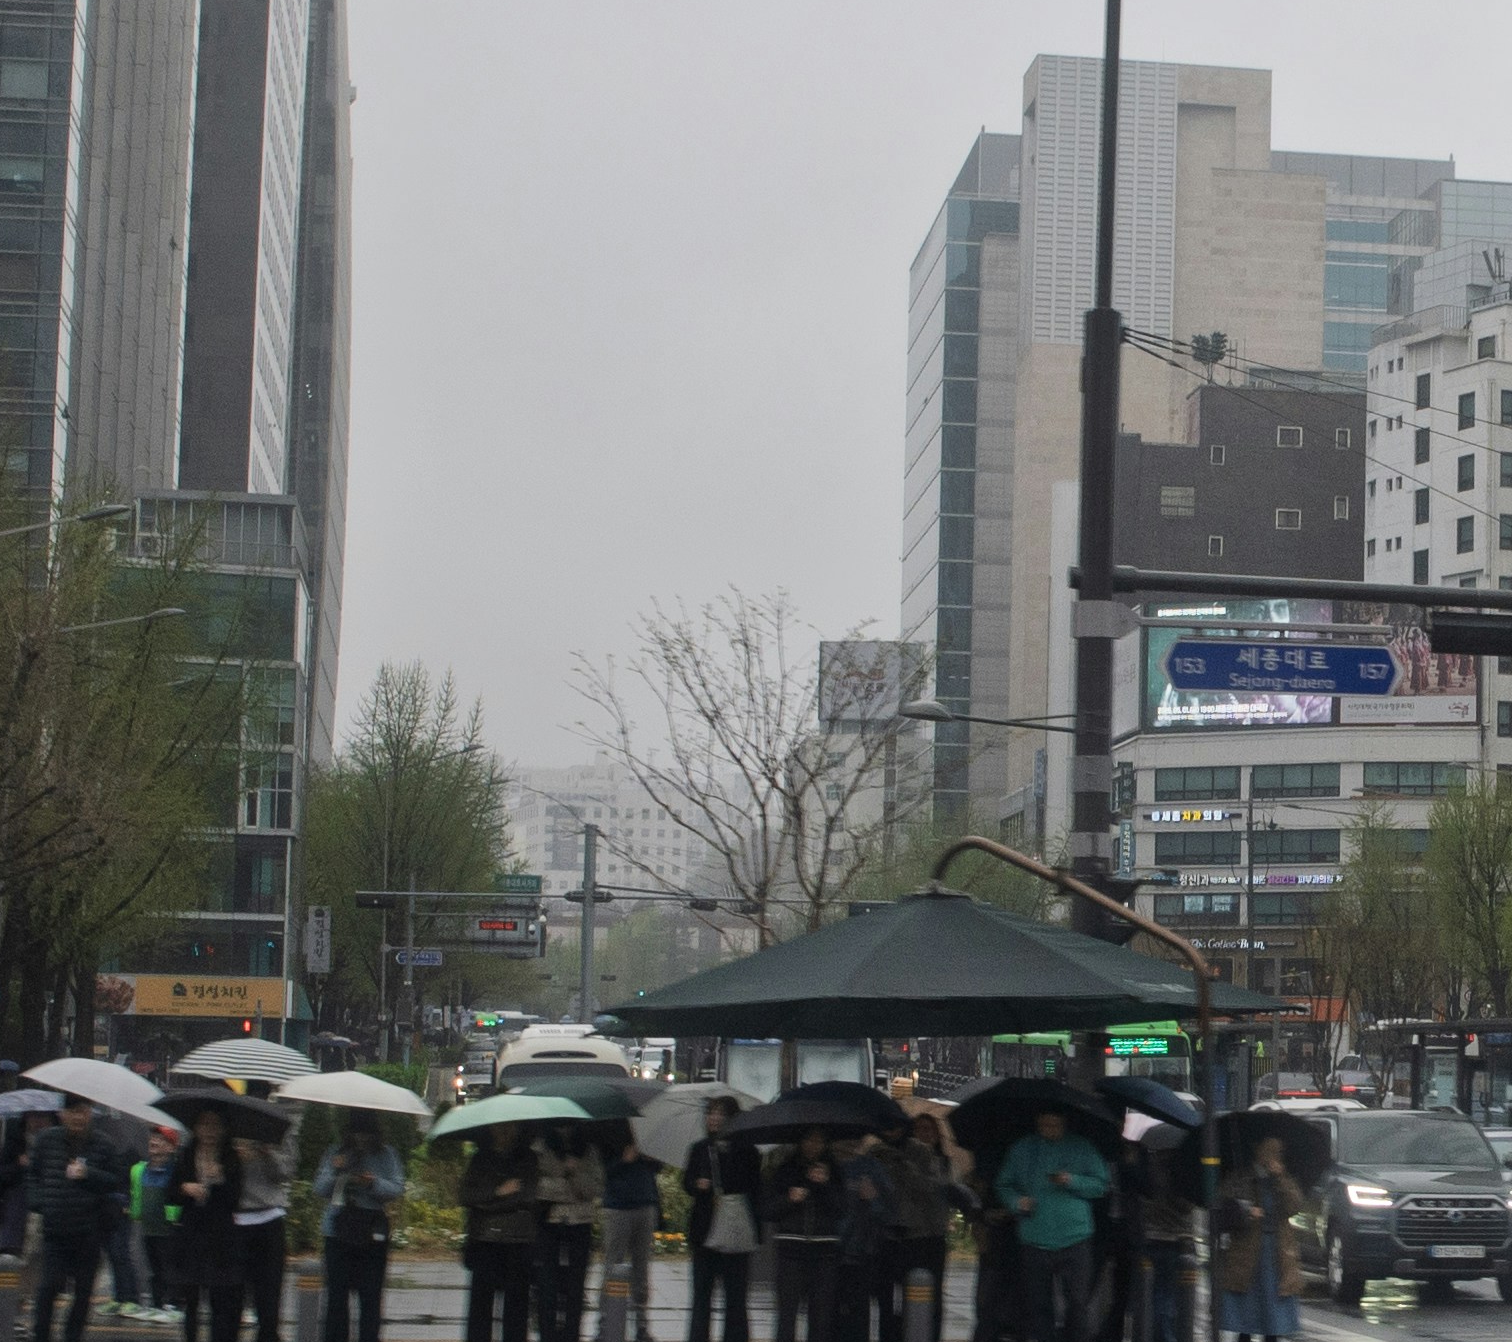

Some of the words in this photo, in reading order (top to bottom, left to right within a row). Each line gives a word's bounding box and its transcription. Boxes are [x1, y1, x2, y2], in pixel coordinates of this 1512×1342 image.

[1173, 657, 1206, 675] 153
[1235, 647, 1330, 671] 세종대로
[1357, 662, 1390, 680] 157
[1228, 671, 1337, 690] Sejong-daero
